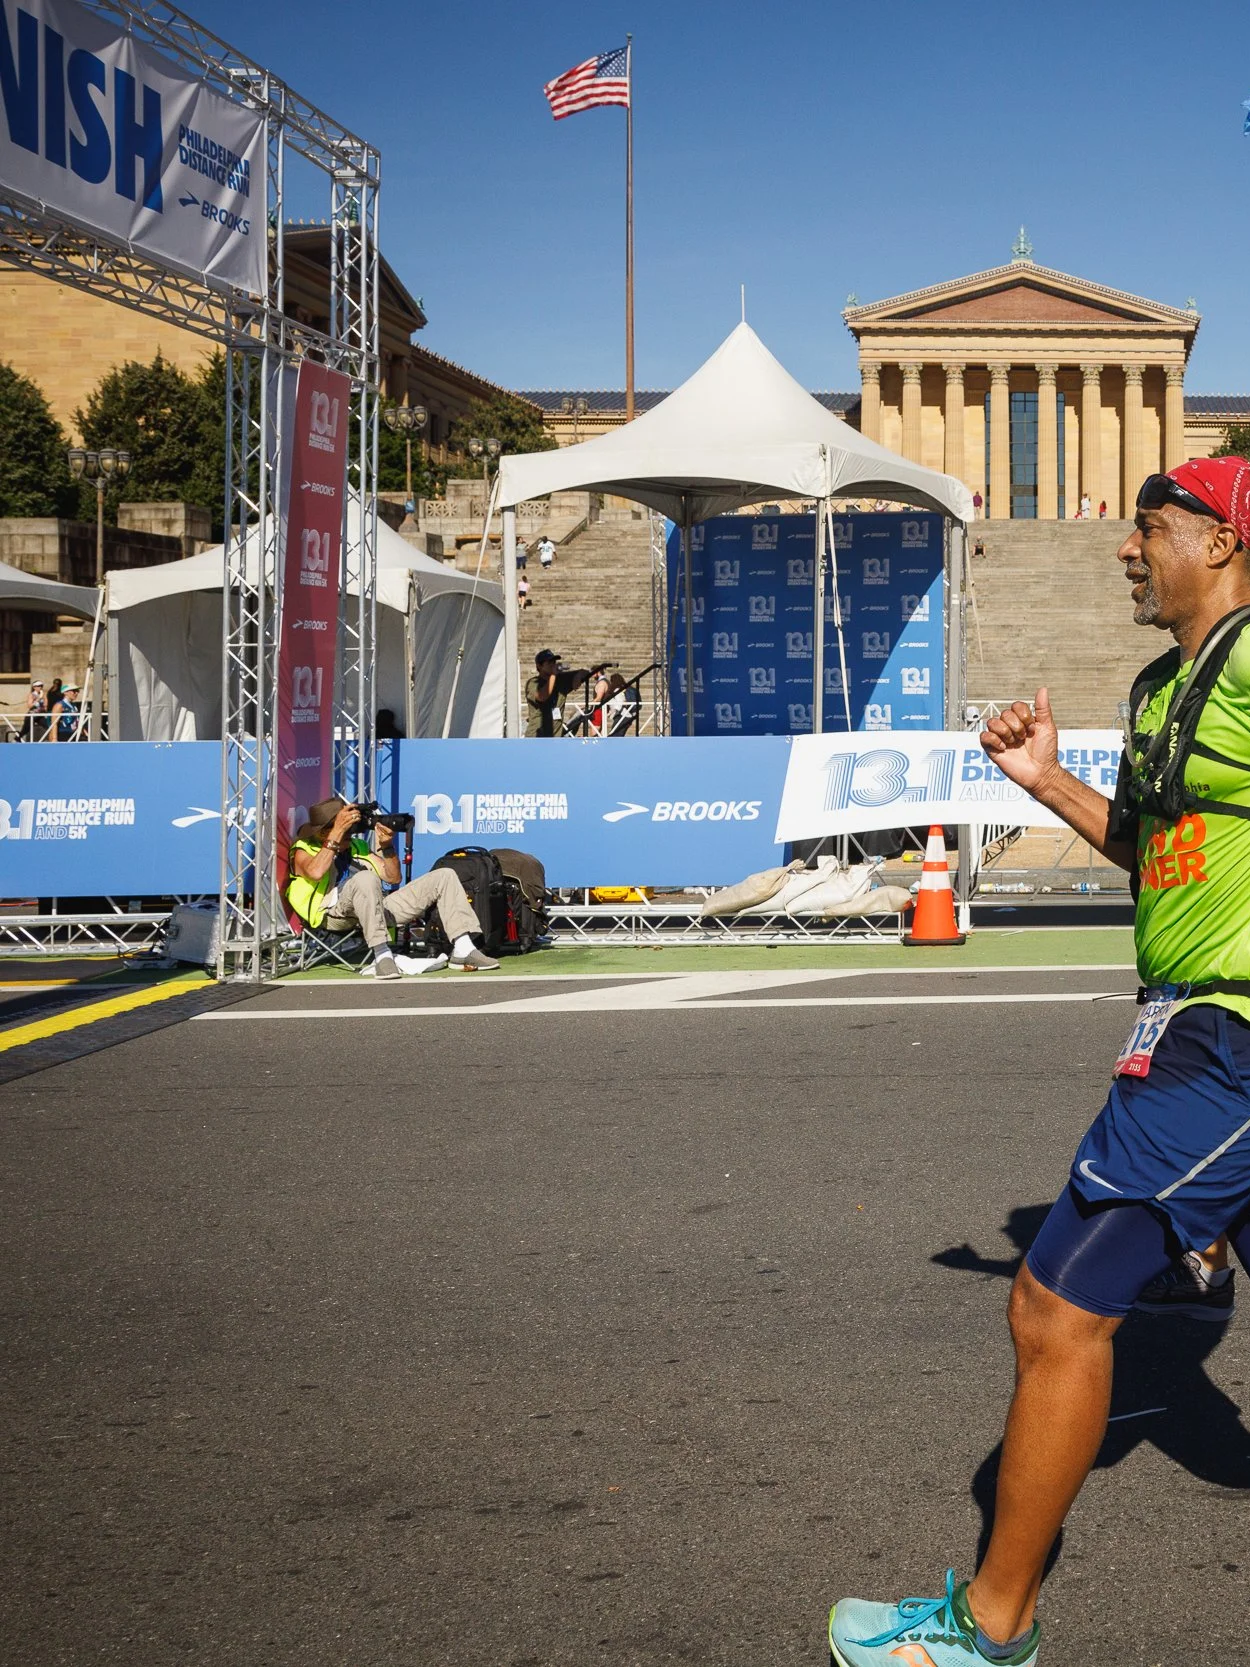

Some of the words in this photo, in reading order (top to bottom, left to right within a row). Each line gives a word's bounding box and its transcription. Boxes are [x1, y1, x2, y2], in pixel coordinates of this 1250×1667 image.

[178, 124, 250, 178] PHILADELPHIA
[178, 144, 226, 186] DISTANCE
[227, 172, 250, 198] RUN
[201, 200, 250, 236] BROOKS
[311, 482, 336, 496] BROOKS
[303, 617, 328, 631] BROOKS
[295, 756, 321, 769] BROOKS
[959, 782, 1025, 802] AND
[37, 798, 135, 813] PHILADELPHIA
[476, 793, 568, 807] PHILADELPHIA
[35, 812, 102, 826] DISTANCE
[104, 811, 135, 826] RUN
[476, 807, 537, 820] DISTANCE
[540, 806, 568, 820] RUN
[651, 801, 763, 822] BROOKS
[34, 826, 68, 840] AND
[68, 826, 88, 840] 5K
[475, 820, 507, 834] AND
[507, 820, 525, 834] 5K
